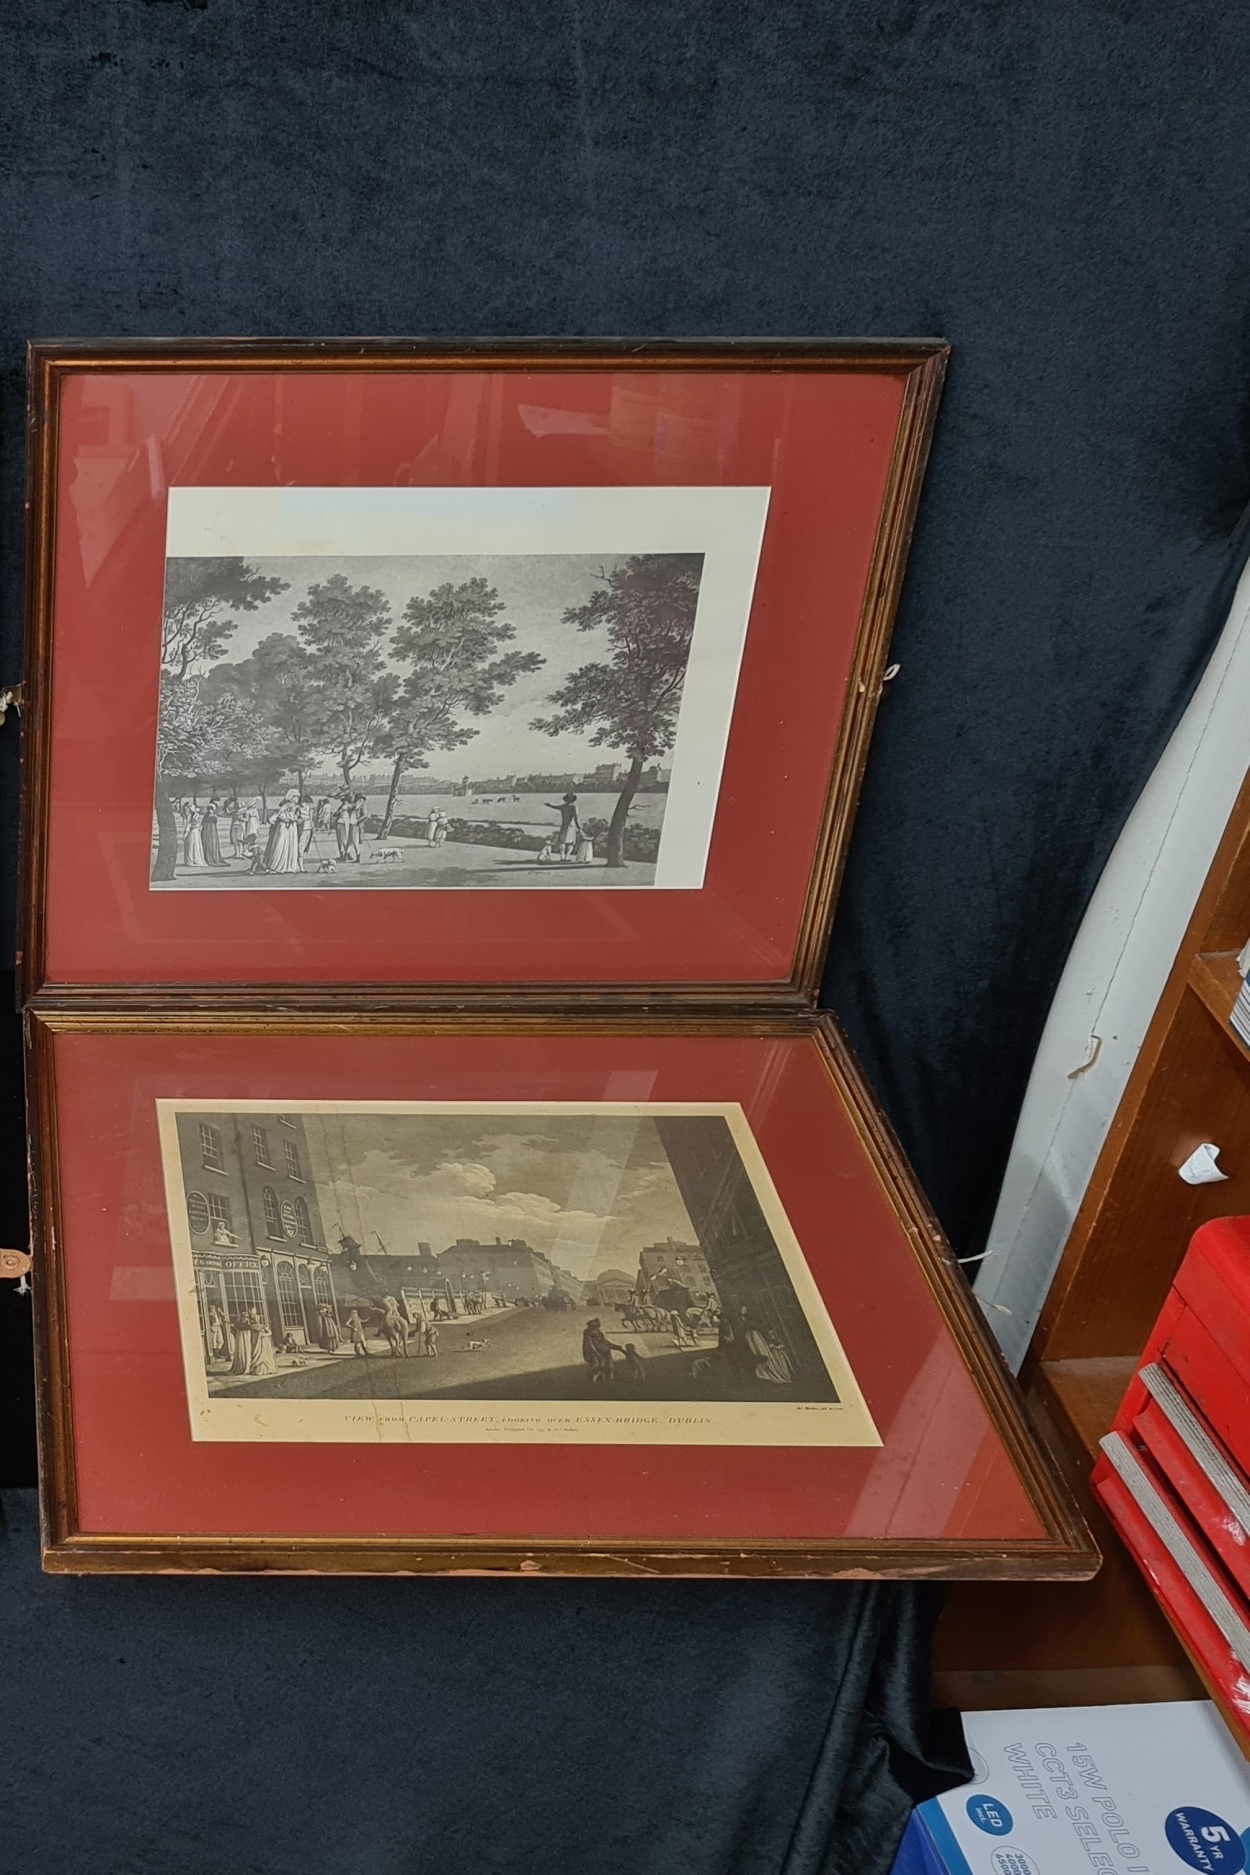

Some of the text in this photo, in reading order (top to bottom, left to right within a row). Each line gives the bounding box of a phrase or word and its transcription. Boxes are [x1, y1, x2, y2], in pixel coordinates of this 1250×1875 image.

[1003, 1742, 1058, 1820] WHITE
[1034, 1742, 1079, 1801] CCT3
[1066, 1742, 1108, 1791] 15W
[1091, 1796, 1141, 1859] POLO
[982, 1803, 1003, 1828] LED
[1174, 1812, 1215, 1871] WARRANTY
[1201, 1825, 1231, 1859] 5 YR
